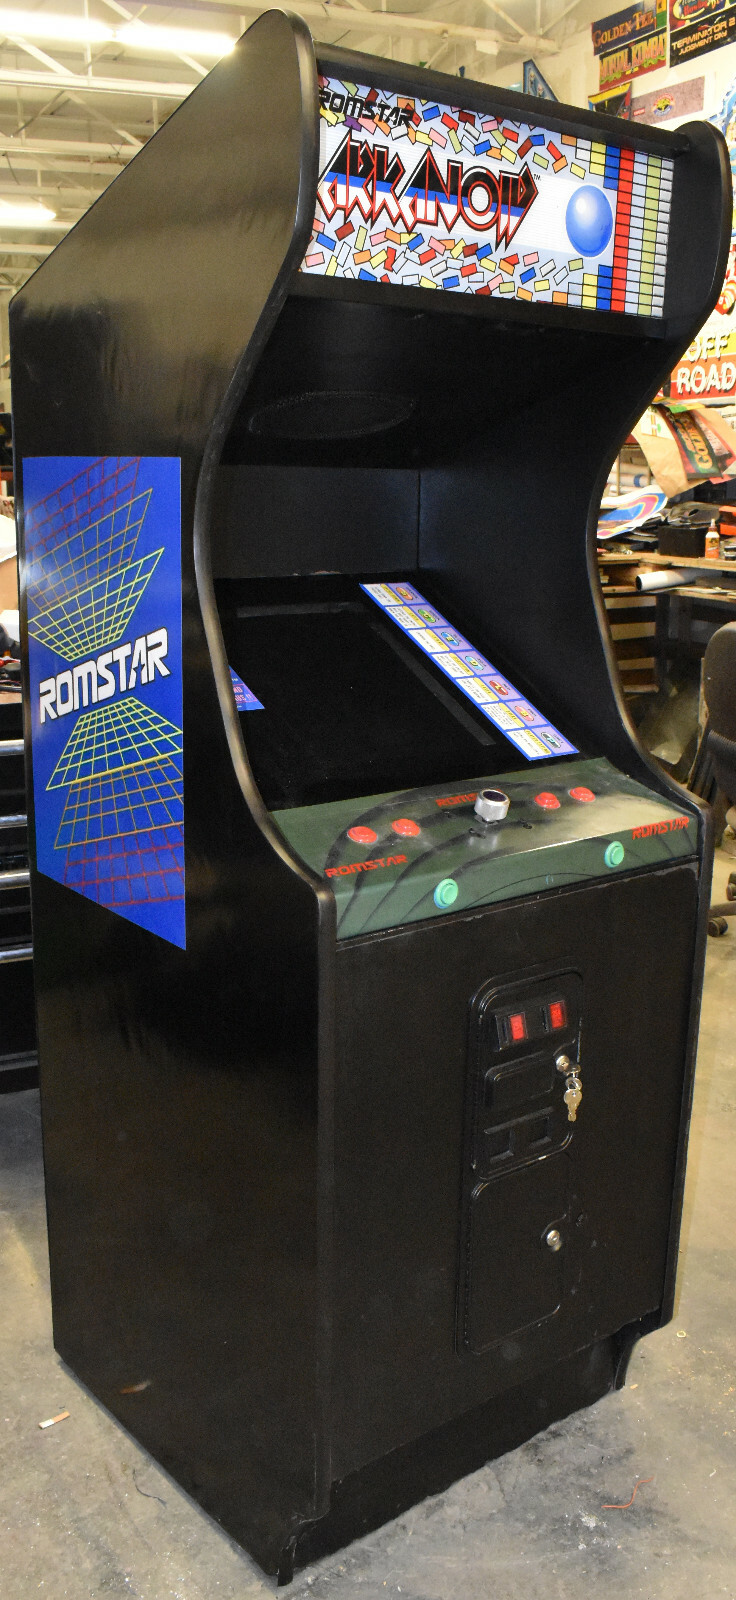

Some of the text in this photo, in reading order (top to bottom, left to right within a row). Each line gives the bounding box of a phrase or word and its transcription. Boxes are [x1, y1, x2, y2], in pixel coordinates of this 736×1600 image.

[593, 11, 654, 48] GOLDEN TEE
[671, 16, 736, 50] TERMINATOR 2
[678, 30, 728, 56] JUDGMENT DAY
[631, 31, 667, 68] KOMBAT
[319, 86, 415, 128] ROMSTAR
[317, 127, 539, 252] ARKANOID
[685, 332, 730, 364] OFF
[676, 361, 736, 396] ROAD
[38, 626, 172, 725] ROMSTAR
[632, 816, 690, 841] ROMSTAR
[325, 854, 408, 878] ROMSTAR
